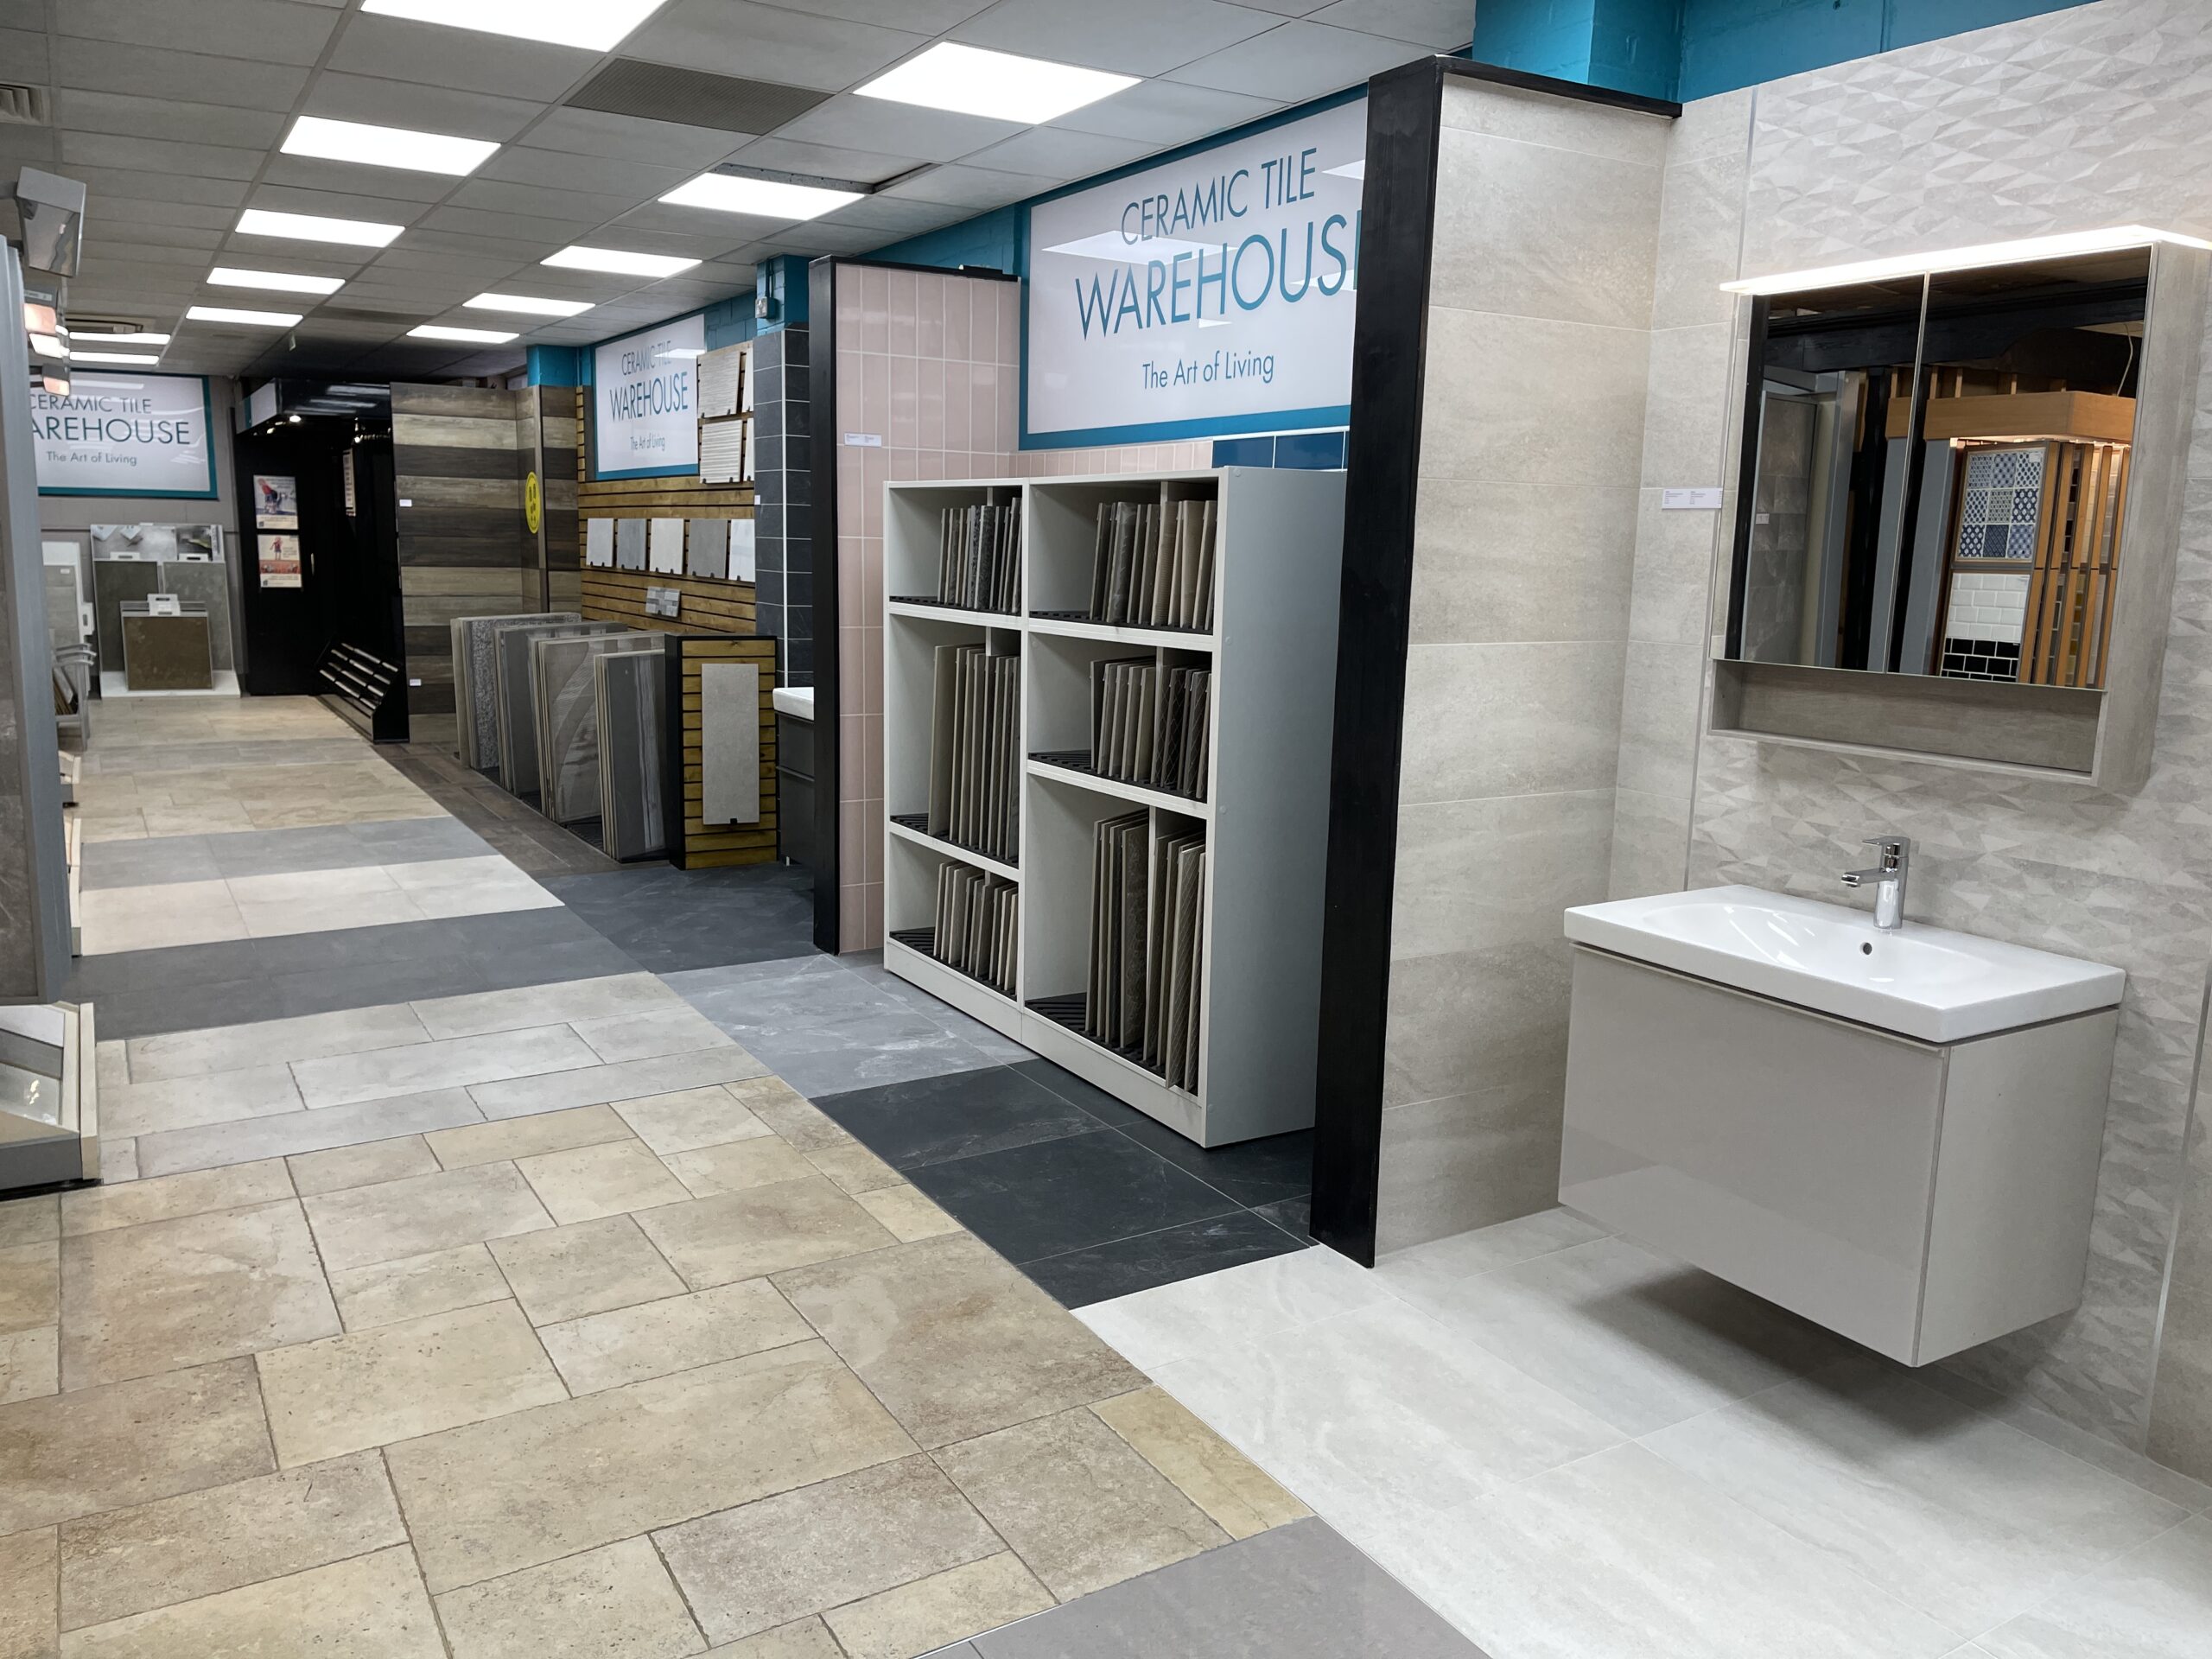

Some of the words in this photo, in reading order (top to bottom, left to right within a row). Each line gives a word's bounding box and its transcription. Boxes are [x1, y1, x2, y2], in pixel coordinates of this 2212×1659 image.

[1122, 168, 1249, 245] CERAMIC
[1261, 147, 1318, 209] TILE
[1075, 209, 1363, 341] WAREHOUS
[621, 346, 655, 376] CERAMIC
[1142, 360, 1167, 389] The
[1173, 359, 1198, 385] Art
[1203, 350, 1220, 382] of
[1225, 351, 1274, 384] Living
[119, 397, 152, 414] TILE
[609, 372, 688, 422] WAREHOUSE
[32, 416, 190, 445] AREHOUSE
[652, 434, 665, 451] Living
[47, 451, 67, 462] The
[71, 452, 87, 462] Art
[91, 452, 103, 463] of
[105, 454, 137, 467] Living
